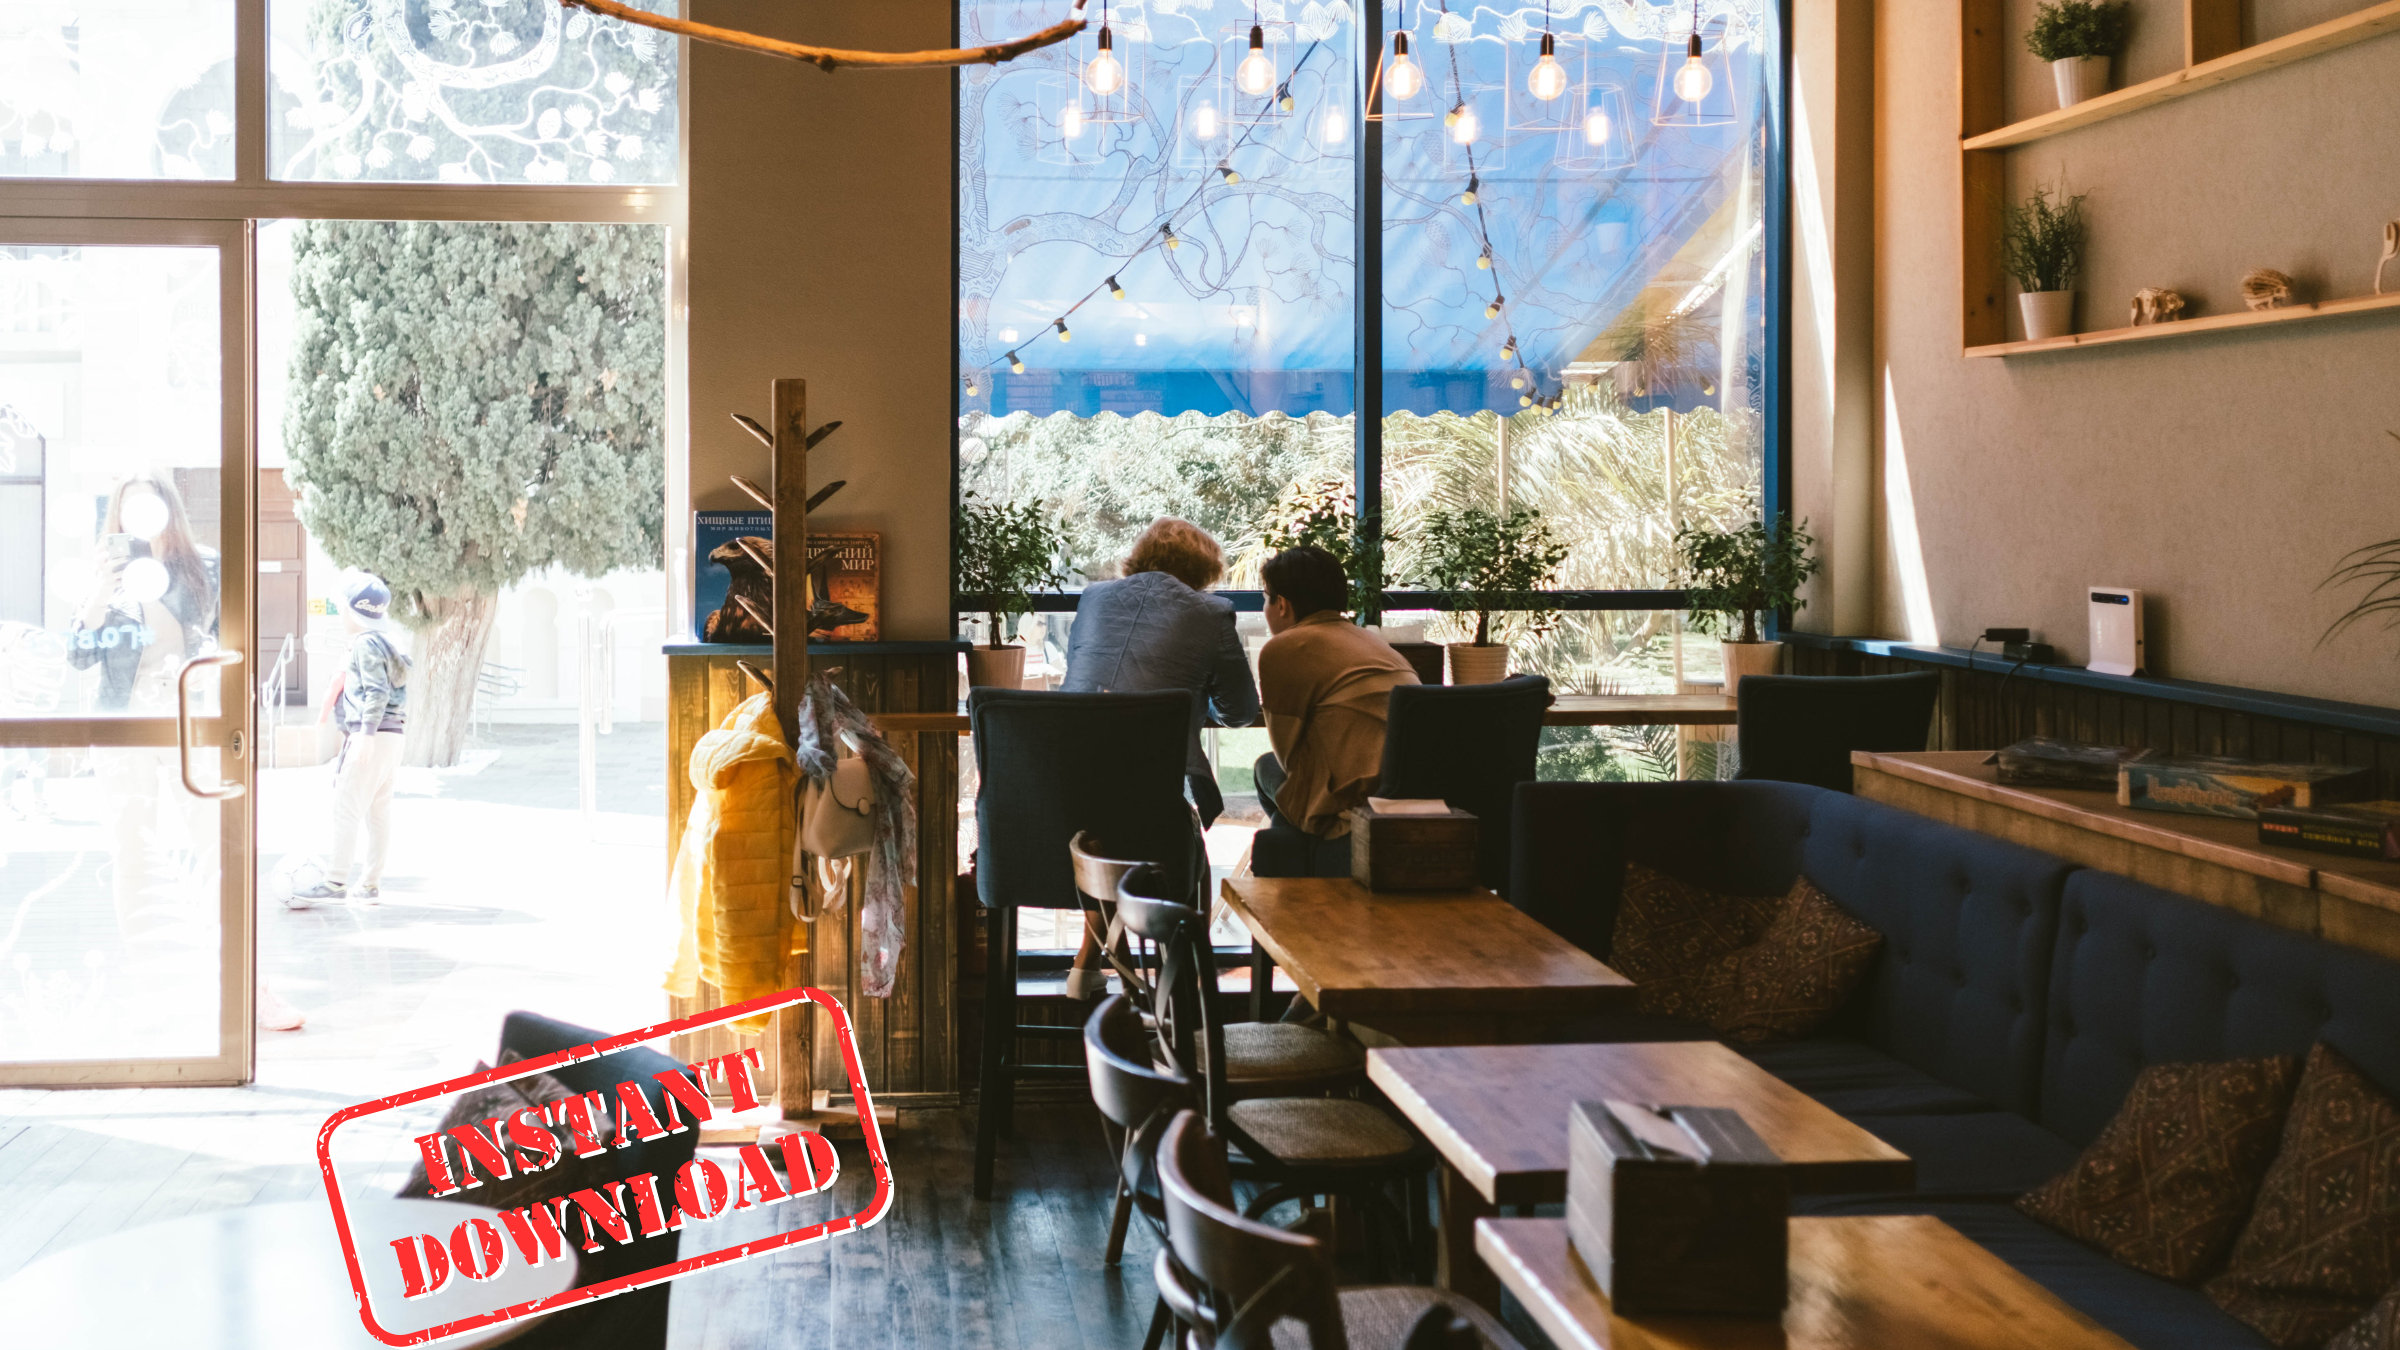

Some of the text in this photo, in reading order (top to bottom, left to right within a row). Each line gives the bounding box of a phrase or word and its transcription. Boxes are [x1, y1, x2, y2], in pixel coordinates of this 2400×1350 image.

[697, 516, 745, 526] ХИЩНЫЕ
[806, 545, 873, 560] ДРНИЙ
[841, 559, 875, 570] МИР
